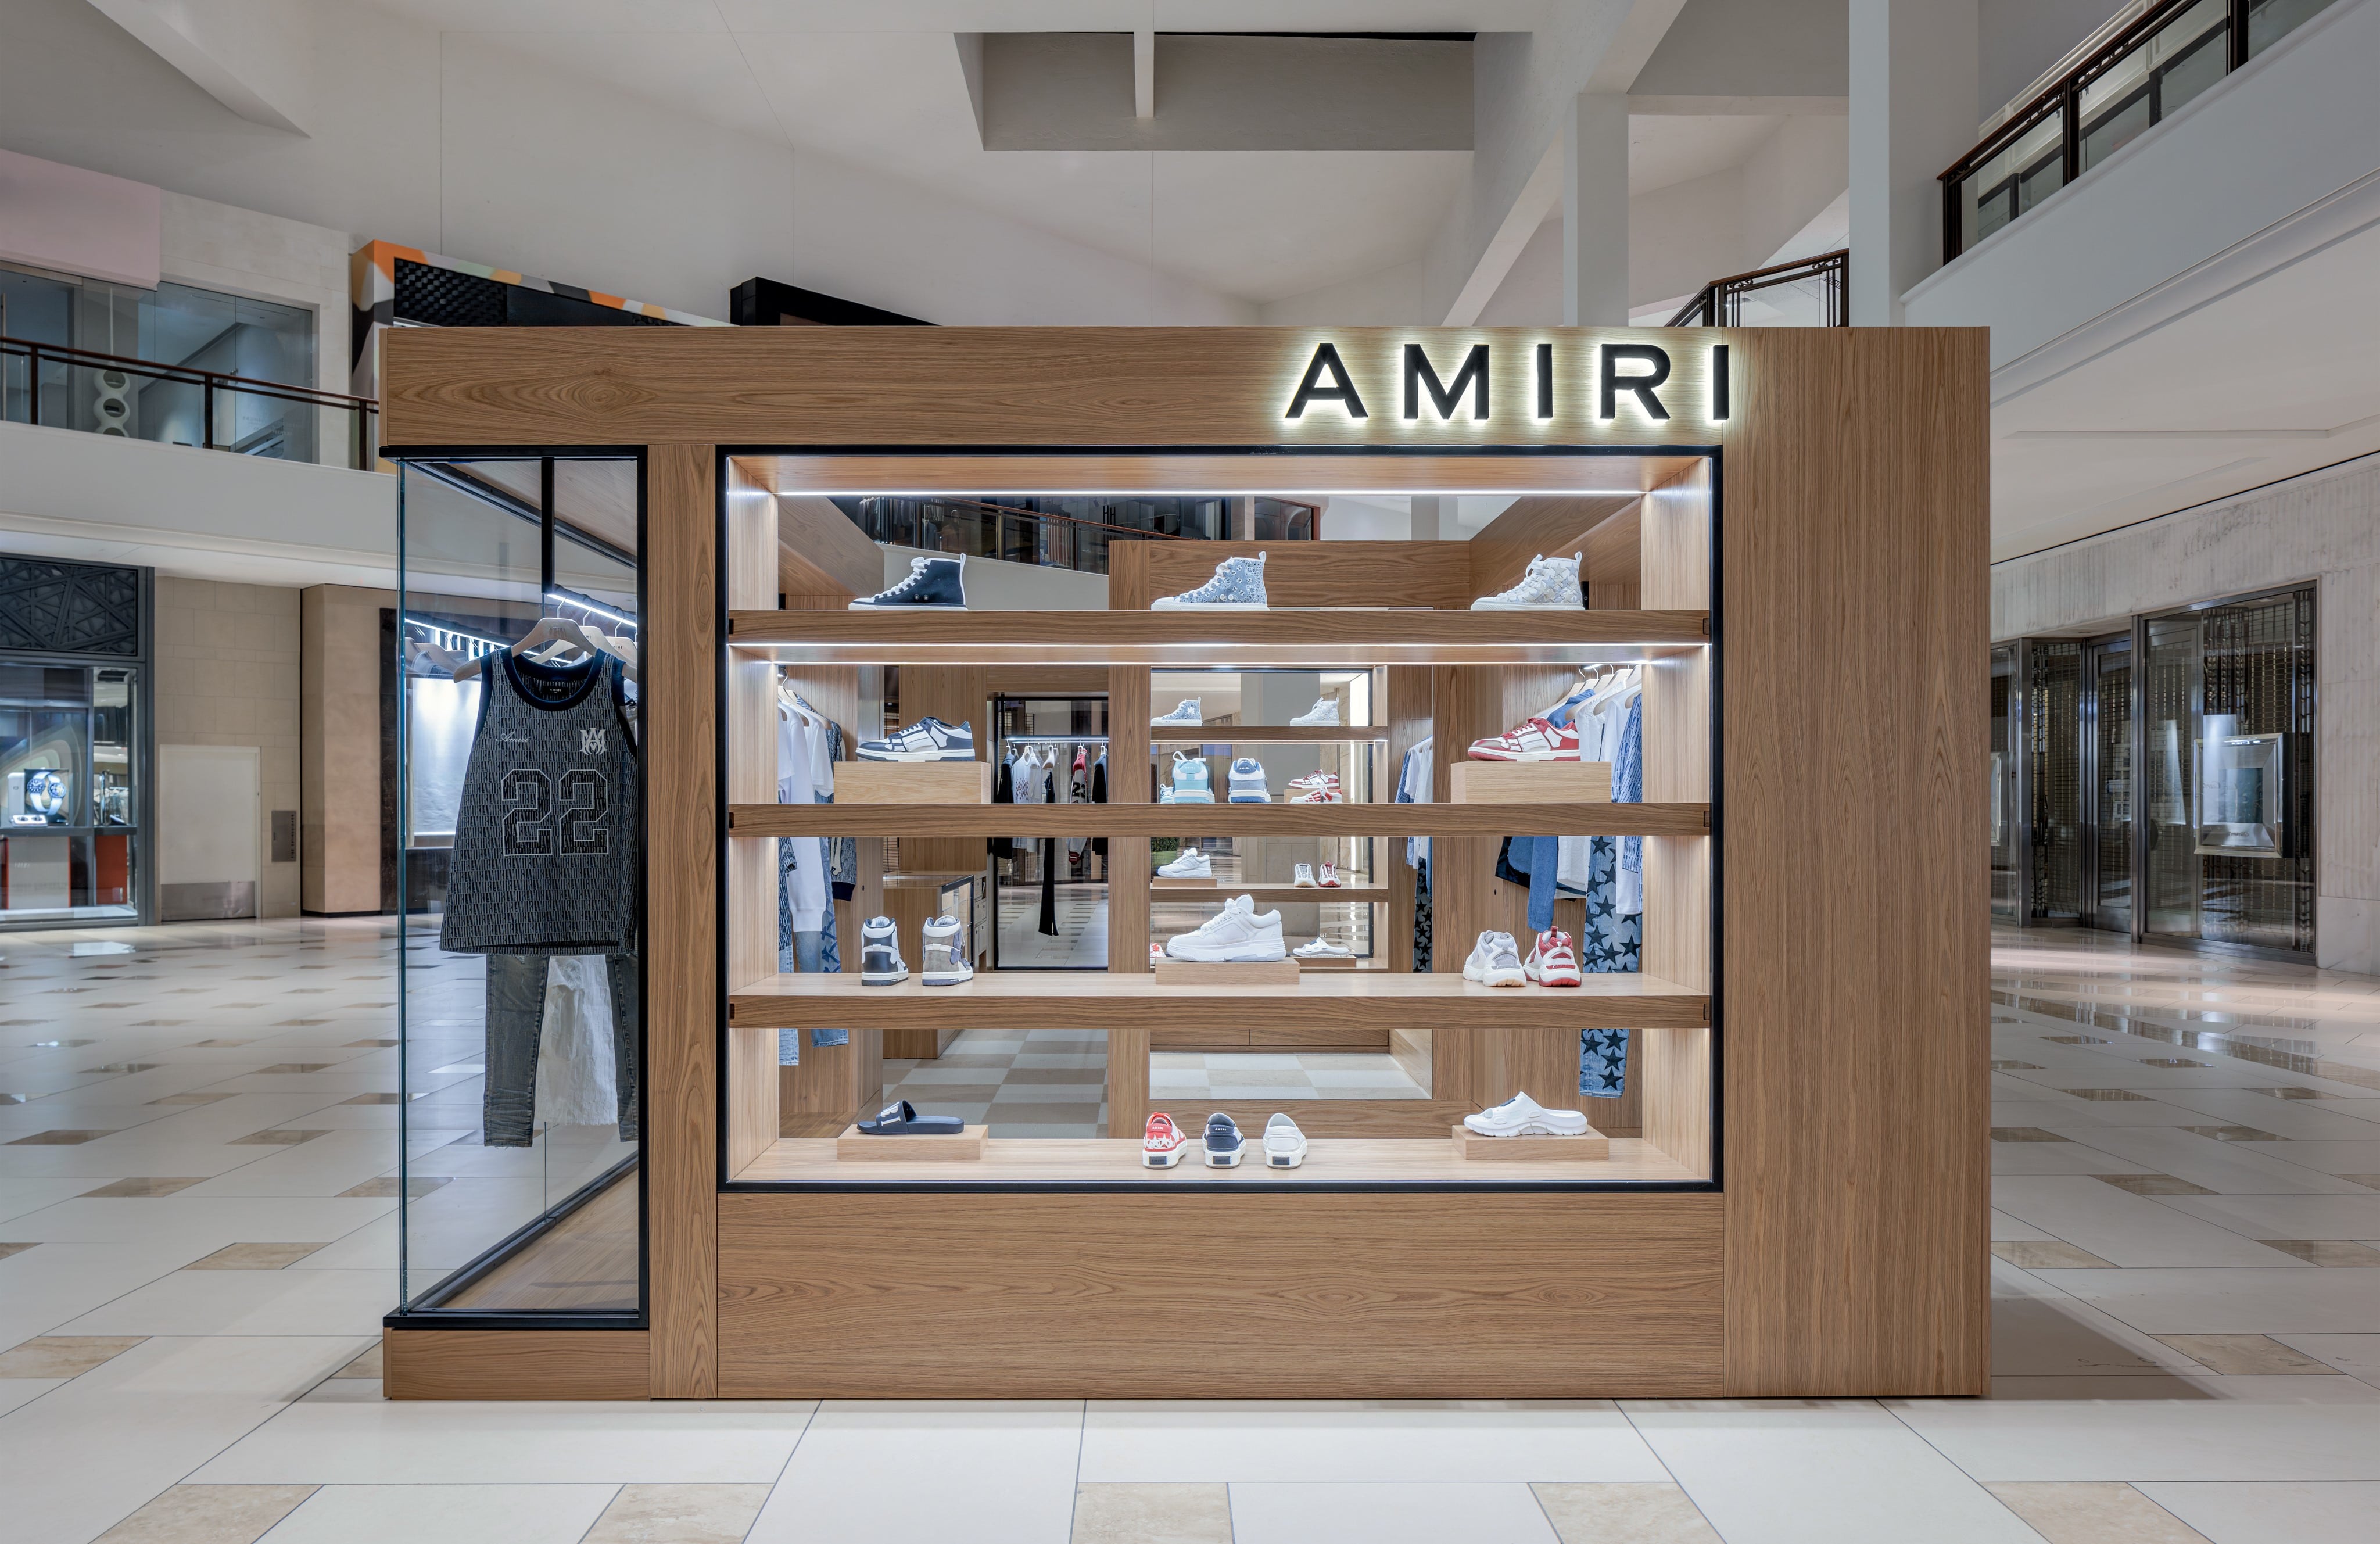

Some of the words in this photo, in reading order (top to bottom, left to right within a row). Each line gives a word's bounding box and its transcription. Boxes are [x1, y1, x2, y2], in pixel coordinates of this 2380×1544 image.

[1284, 343, 1729, 420] AMIRI
[496, 730, 529, 743] Amiri
[501, 769, 610, 857] 22
